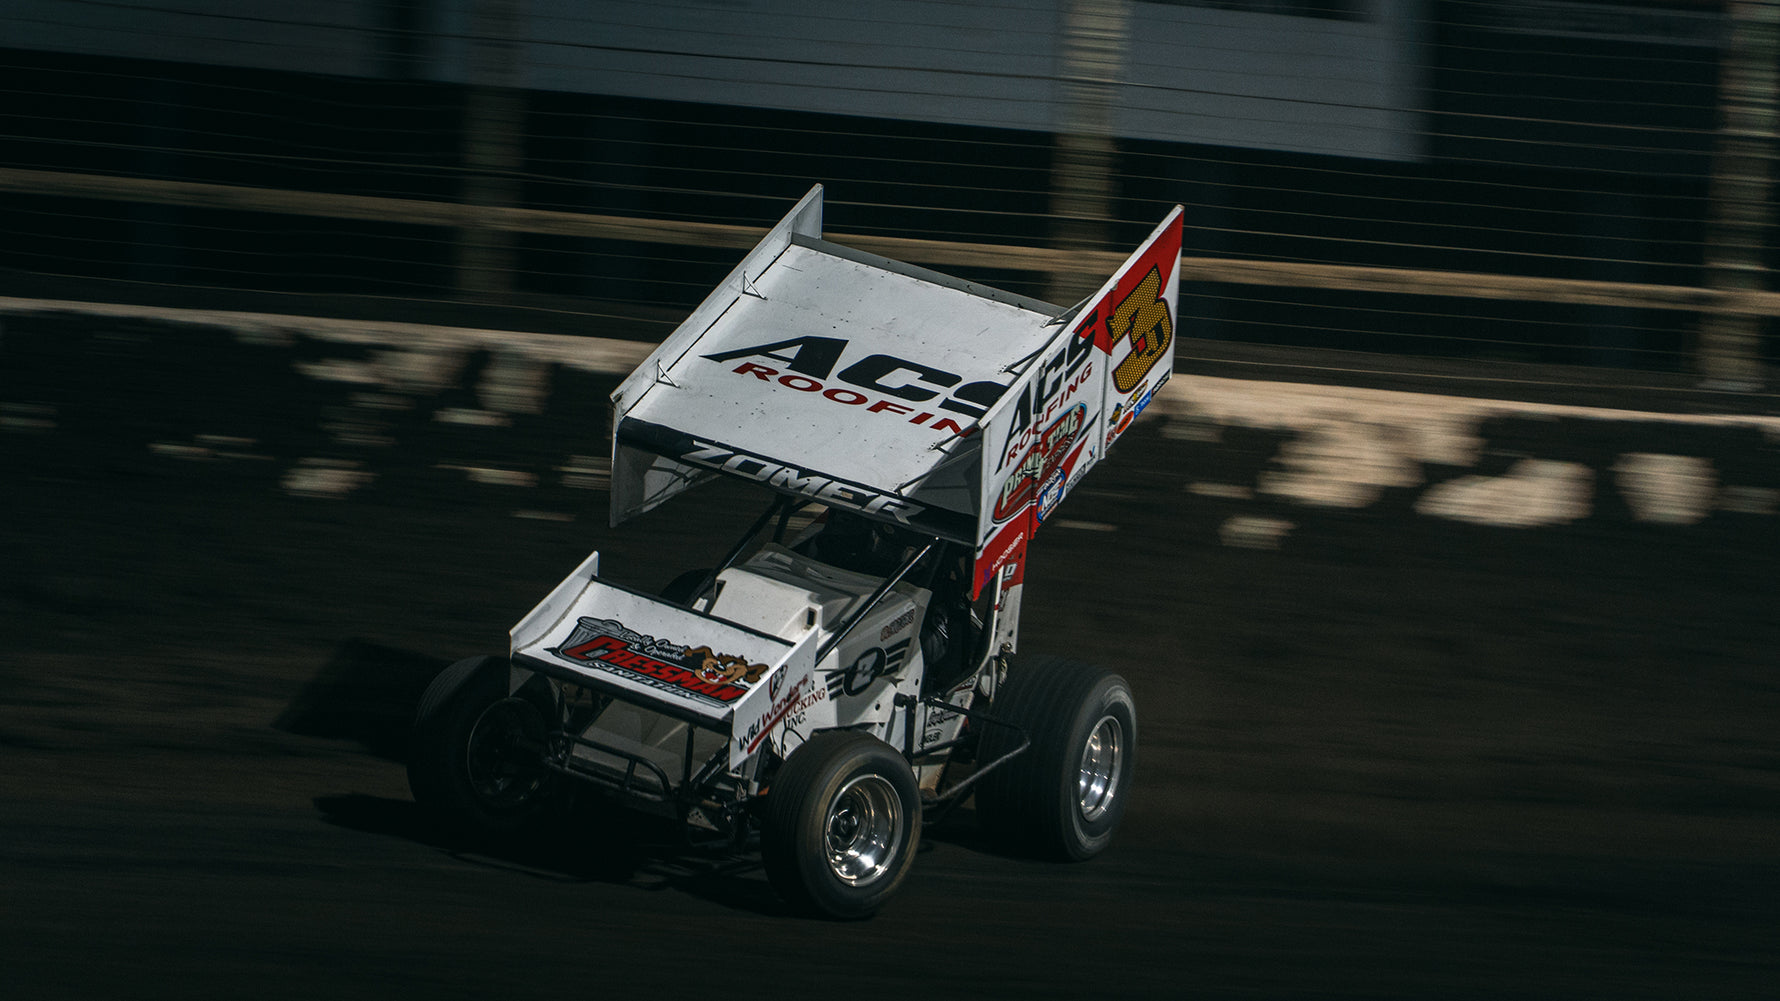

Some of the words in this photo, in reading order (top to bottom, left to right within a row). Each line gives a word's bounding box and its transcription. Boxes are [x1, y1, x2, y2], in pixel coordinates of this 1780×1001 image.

[1105, 264, 1173, 395] 3
[995, 309, 1098, 475] ACS
[1005, 362, 1093, 468] ROOFING
[1046, 405, 1081, 453] TIME
[681, 439, 927, 525] ZOMER
[588, 661, 697, 699] SANITATION
